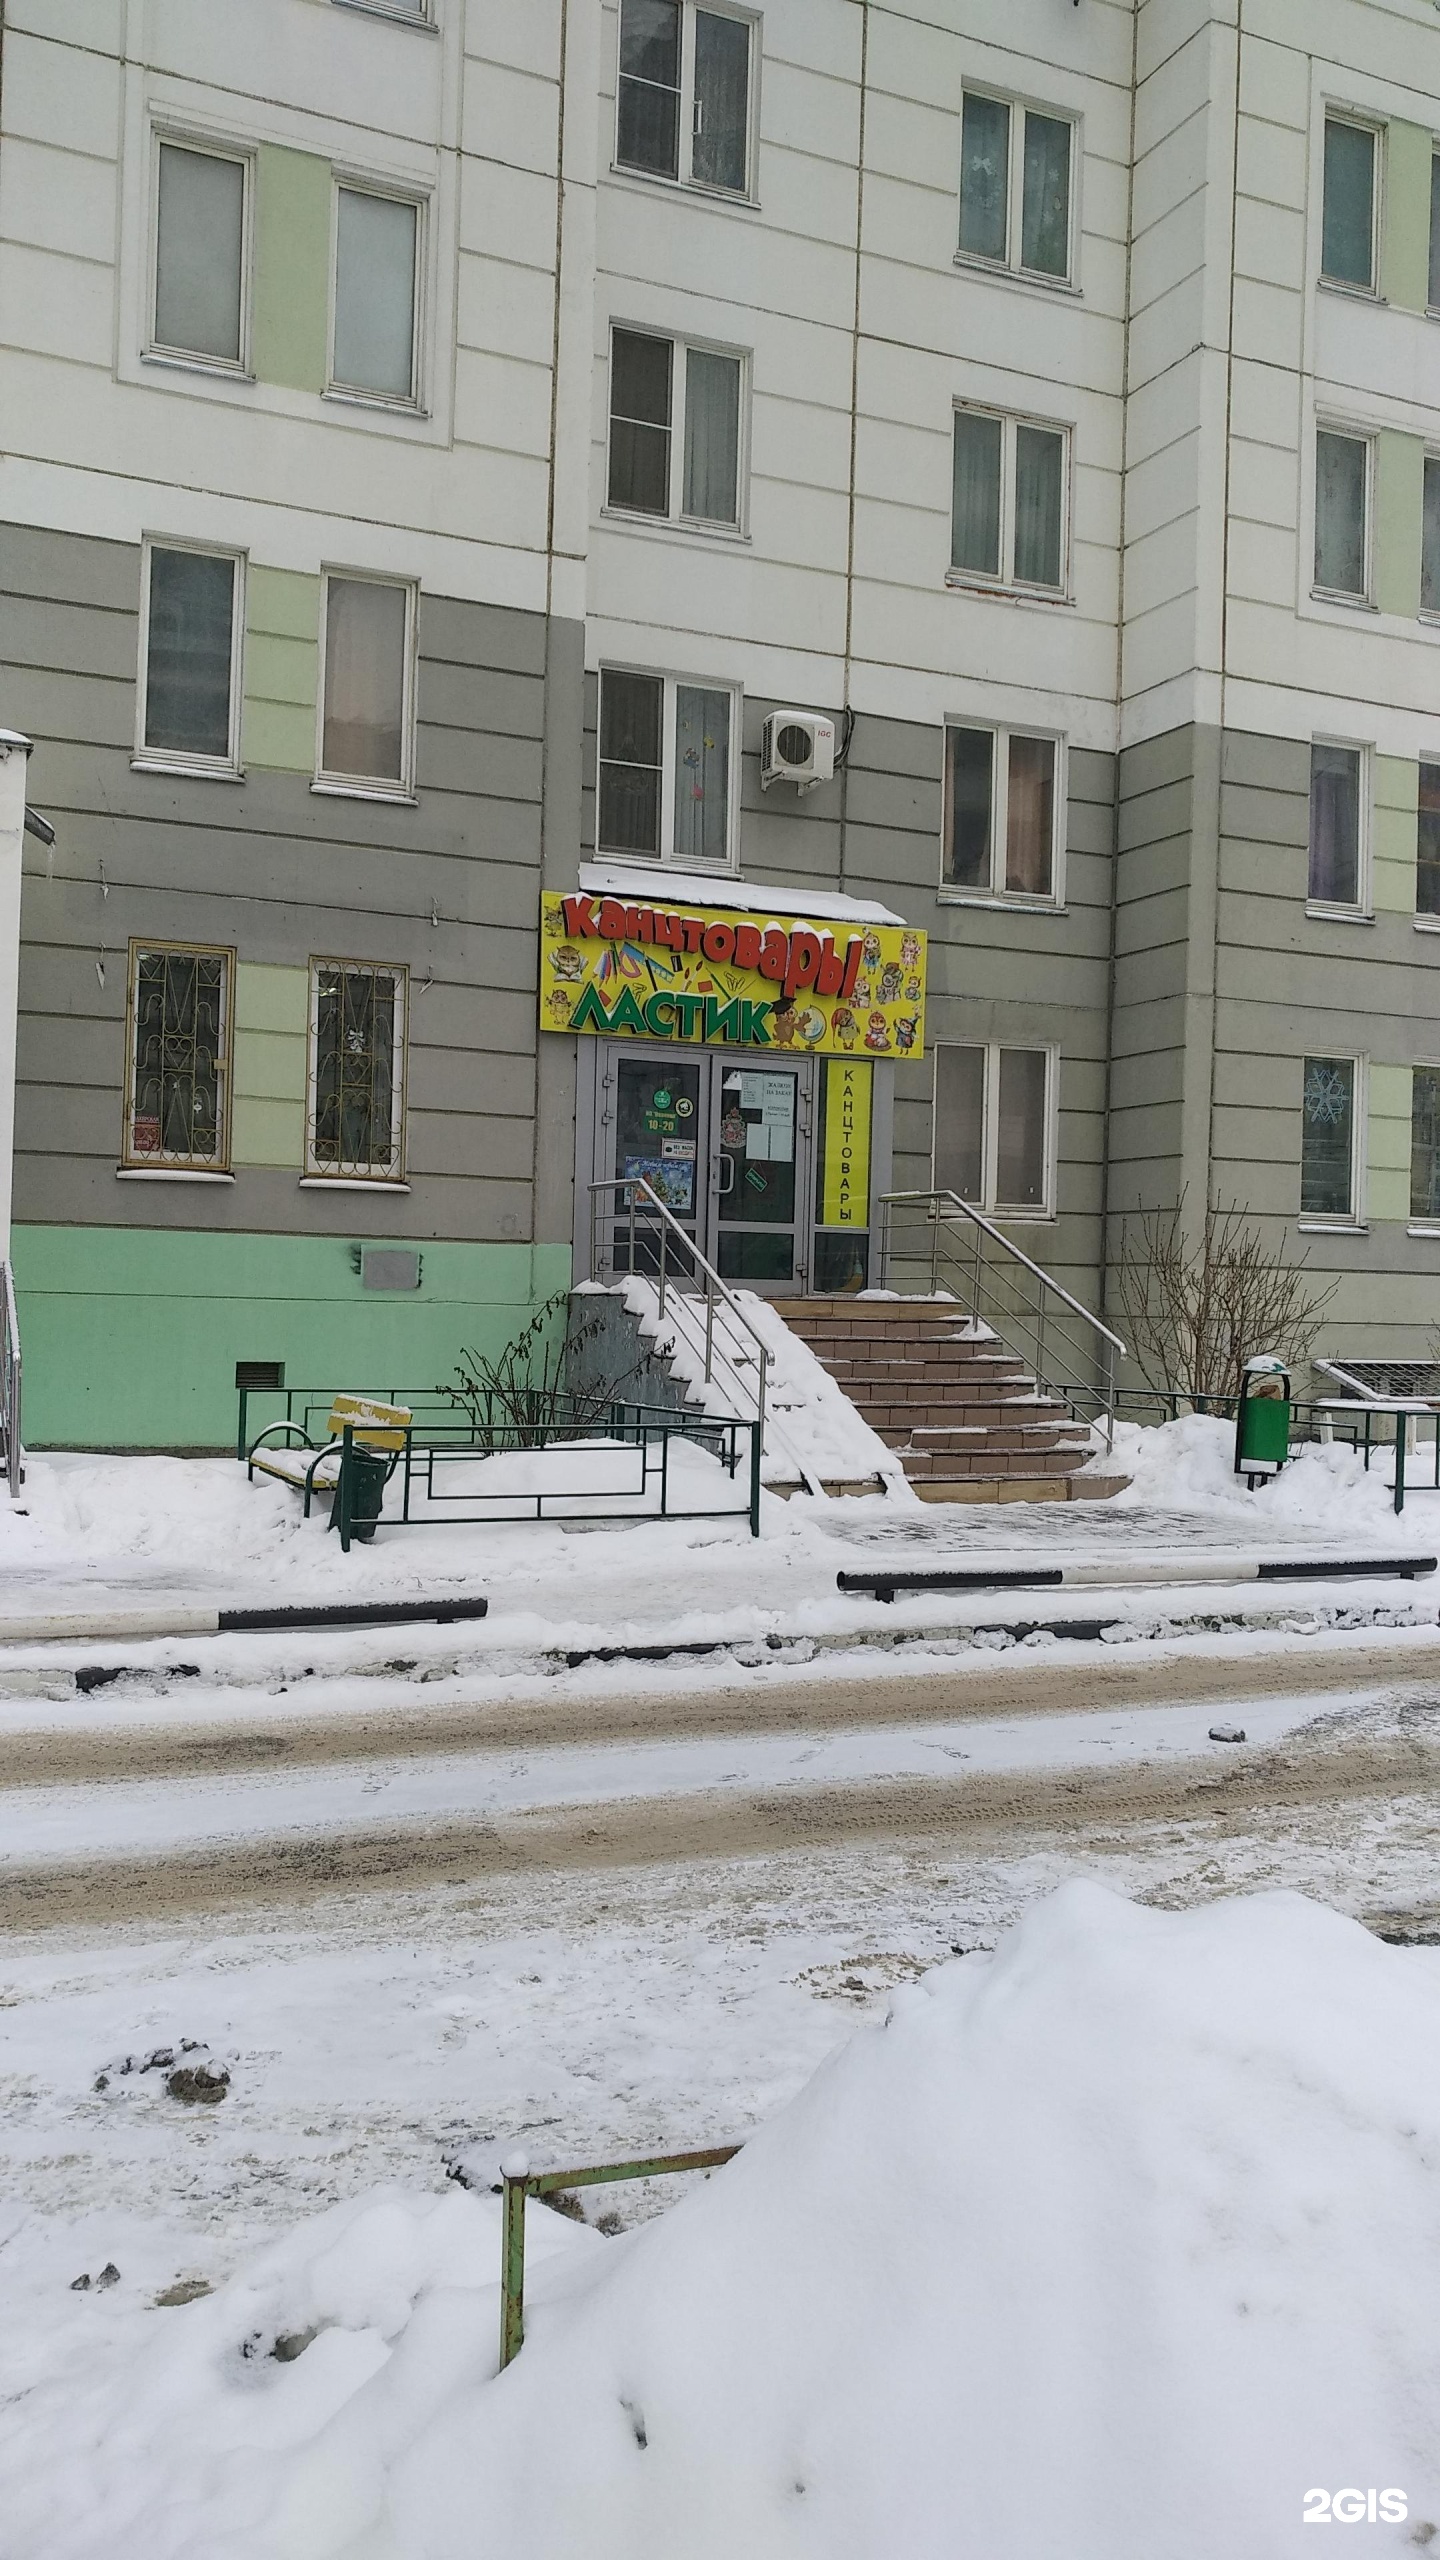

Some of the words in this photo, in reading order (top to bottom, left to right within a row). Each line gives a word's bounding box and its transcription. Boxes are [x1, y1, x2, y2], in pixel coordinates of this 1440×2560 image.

[561, 894, 863, 999] Канцтовары
[568, 981, 774, 1045] ЛАСТИК
[648, 1119, 674, 1132] 10-20
[839, 1069, 854, 1220] КАНЦТОВАРЫ
